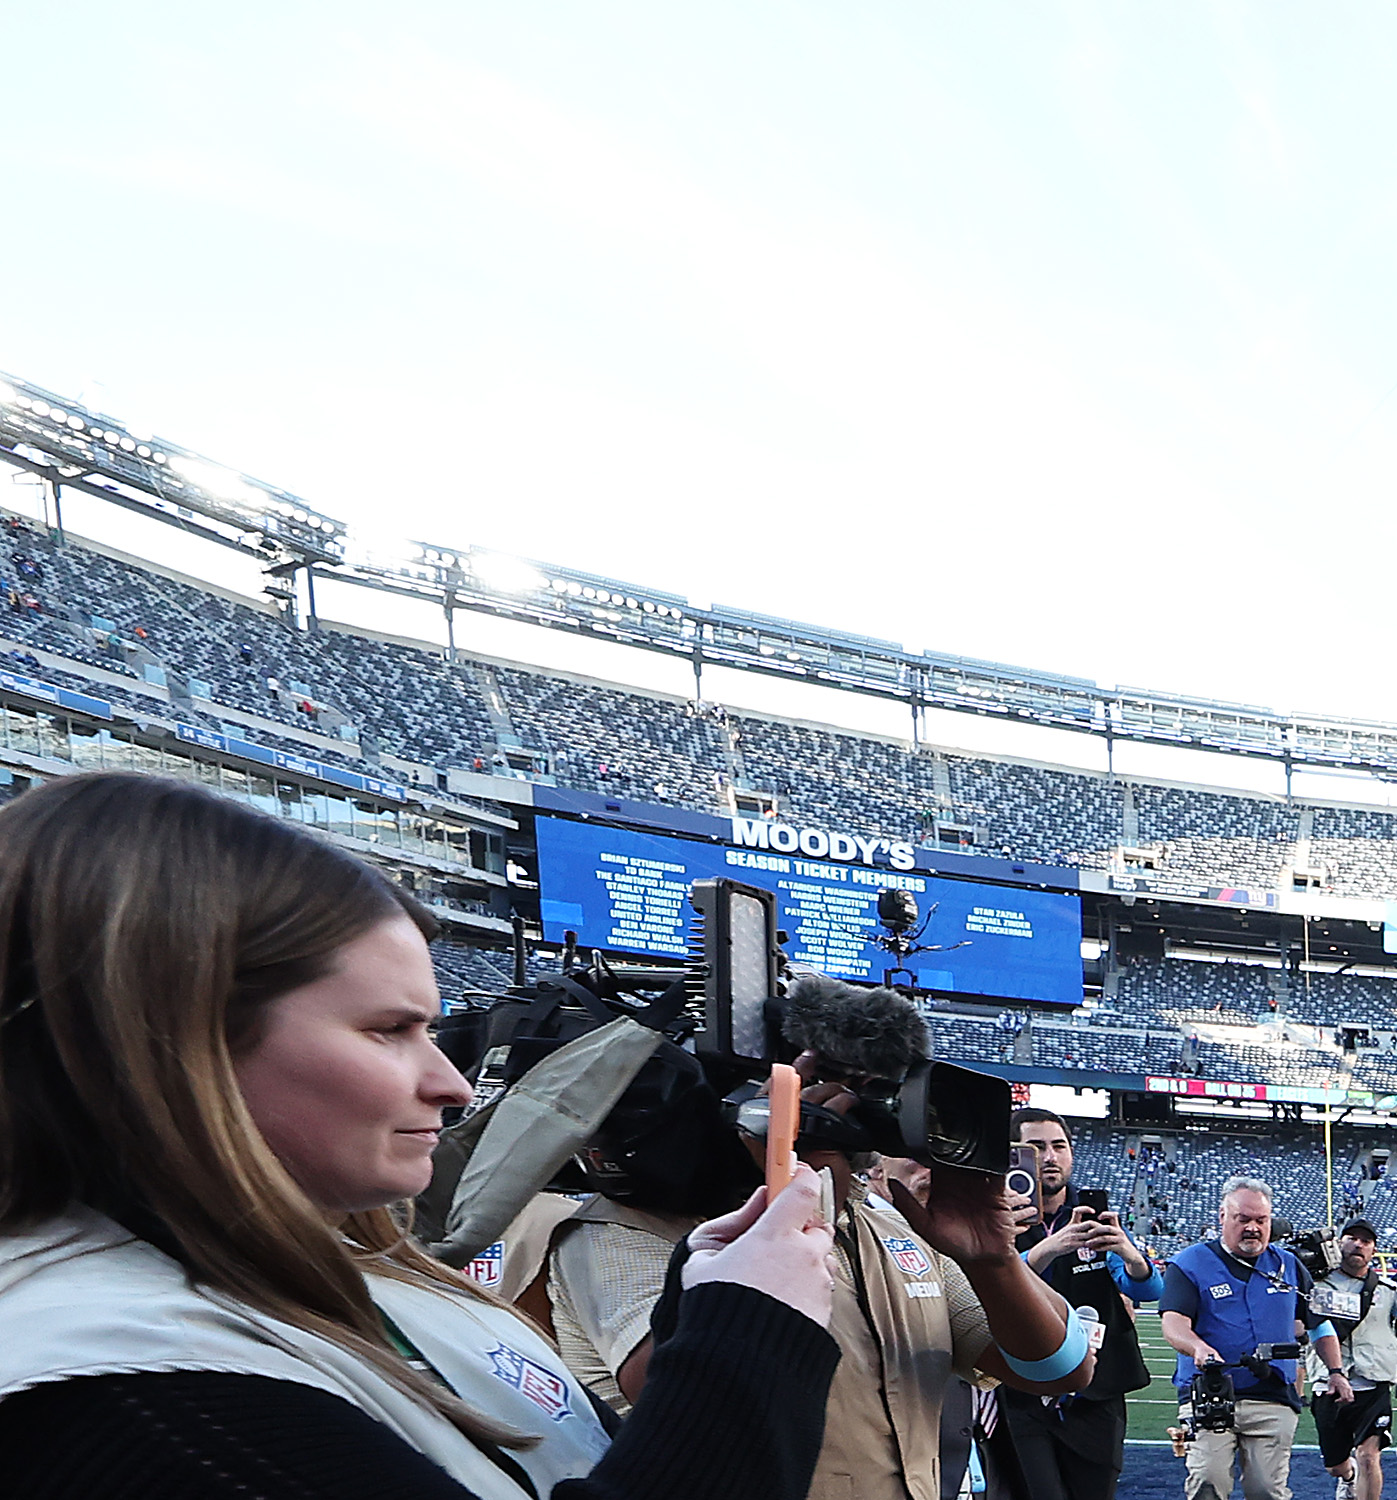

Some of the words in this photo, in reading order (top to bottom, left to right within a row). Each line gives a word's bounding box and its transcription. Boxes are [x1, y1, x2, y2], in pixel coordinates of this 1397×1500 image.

[732, 818, 915, 870] MOODY'S
[600, 853, 629, 865] BRIAN
[638, 868, 663, 879] BANK
[725, 850, 791, 873] SEASON
[794, 860, 849, 882] TICKET
[852, 868, 926, 893] MEMBERS
[595, 870, 613, 880] THE
[659, 880, 692, 892] FAMILY
[605, 881, 645, 894] STANLEY
[646, 887, 684, 900] THOMAS
[609, 891, 643, 903] DENNIS
[790, 890, 821, 902] HARRIS
[824, 887, 880, 901] WASHINGTON
[614, 901, 643, 912] ANGEL
[644, 905, 678, 917] TORRES
[784, 907, 820, 919] PATRICK
[973, 906, 995, 917] STAN
[609, 909, 643, 921] UNITED
[643, 914, 684, 926] AIRLINES
[967, 914, 1002, 926] MICHAEL
[619, 920, 638, 930] BEN
[795, 926, 828, 937] JOSEPH
[966, 922, 984, 932] ERIC
[985, 925, 1033, 938] ZUCKERMAN
[611, 927, 650, 940] RICHARD
[651, 933, 684, 944] WALSH
[800, 935, 827, 946] SCOTT
[606, 936, 646, 949] WARREN
[807, 945, 825, 954] BOB
[826, 947, 858, 958] WOODS
[895, 1251, 926, 1271] NFL
[904, 1281, 941, 1298] MEDIA
[1211, 1285, 1232, 1297] SDS
[523, 1369, 563, 1415] NFL
